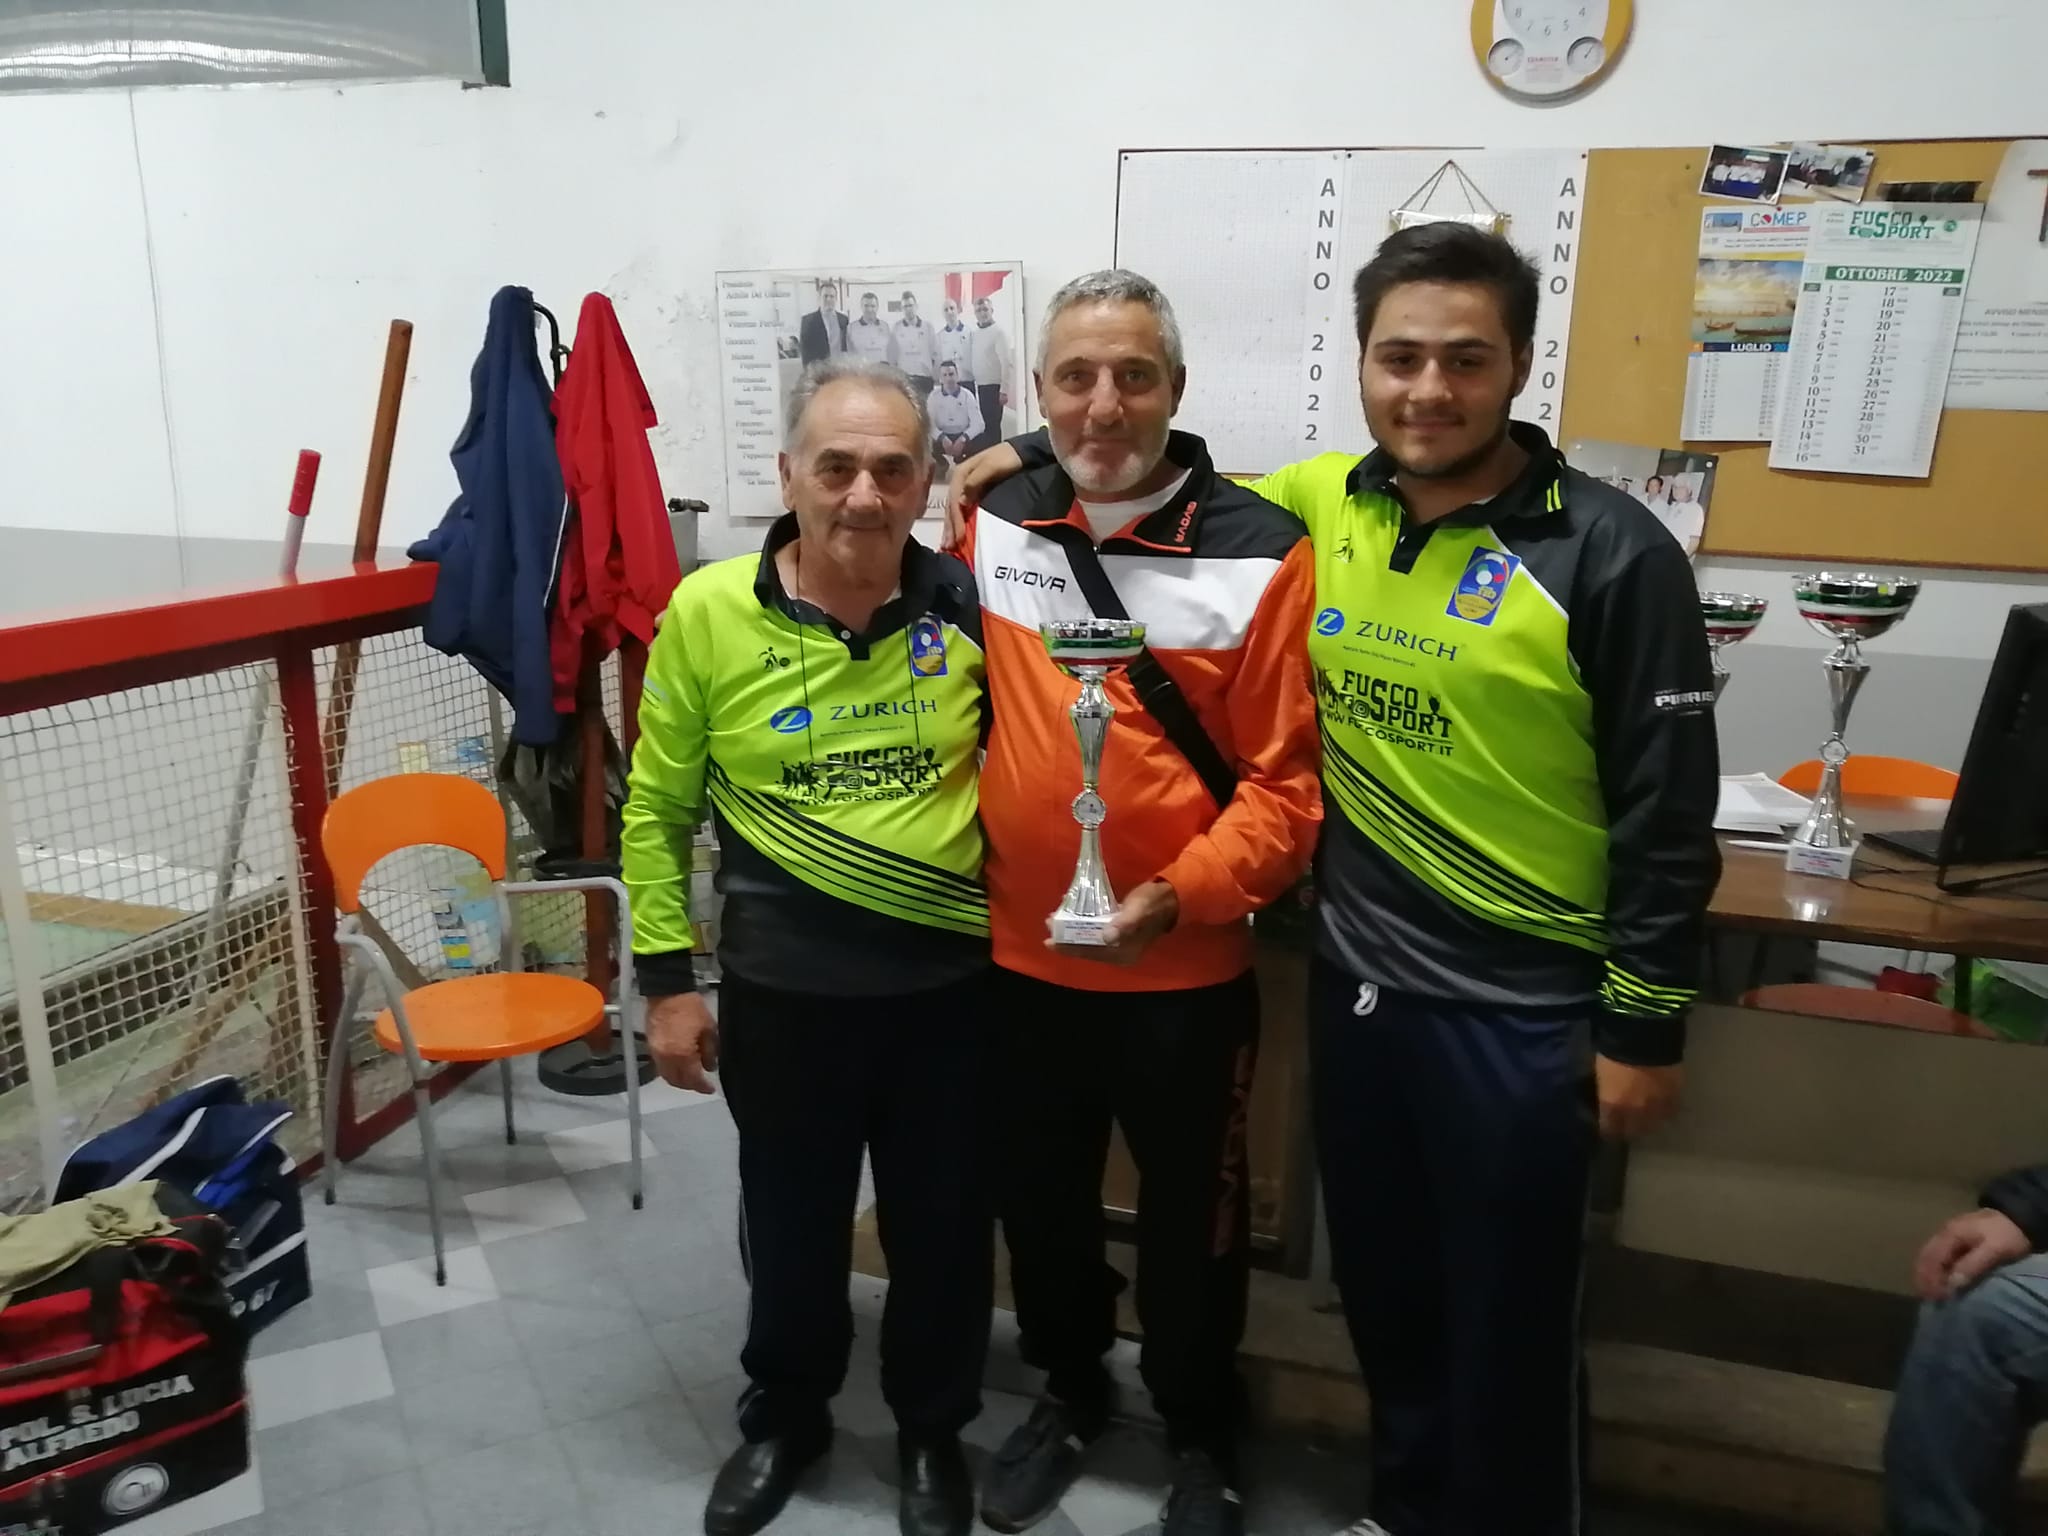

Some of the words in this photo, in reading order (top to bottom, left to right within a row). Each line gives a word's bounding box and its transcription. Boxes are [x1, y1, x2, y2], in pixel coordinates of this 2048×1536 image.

[1313, 178, 1336, 290] ANNO
[1550, 177, 1577, 295] ANNO
[1835, 267, 1908, 281] OTTOBRE
[1914, 270, 1953, 282] 2022
[1884, 286, 1896, 296] 17
[1881, 298, 1895, 308] 18
[1879, 310, 1893, 319] 19
[1876, 321, 1890, 331] 20
[1875, 333, 1886, 342] 21
[1730, 343, 1772, 352] LUGLIO
[1870, 355, 1884, 365] 23
[1867, 367, 1881, 376] 24
[1538, 340, 1559, 420] 202
[1866, 378, 1880, 388] 25
[1304, 334, 1325, 441] 2022
[1807, 386, 1820, 396] 10
[1863, 390, 1878, 399] 26
[1806, 398, 1816, 407] 11
[1861, 401, 1875, 410] 27
[1803, 409, 1816, 418] 12
[1859, 412, 1874, 421] 28
[1802, 420, 1814, 429] 13
[1799, 431, 1811, 441] 14
[1855, 434, 1870, 444] 30
[1853, 445, 1866, 455] 31
[1795, 453, 1808, 463] 16
[994, 566, 1066, 593] GIVOVA
[1355, 620, 1459, 662] ZURICH
[1341, 669, 1418, 711] FUSCO
[829, 699, 937, 721] ZURICH
